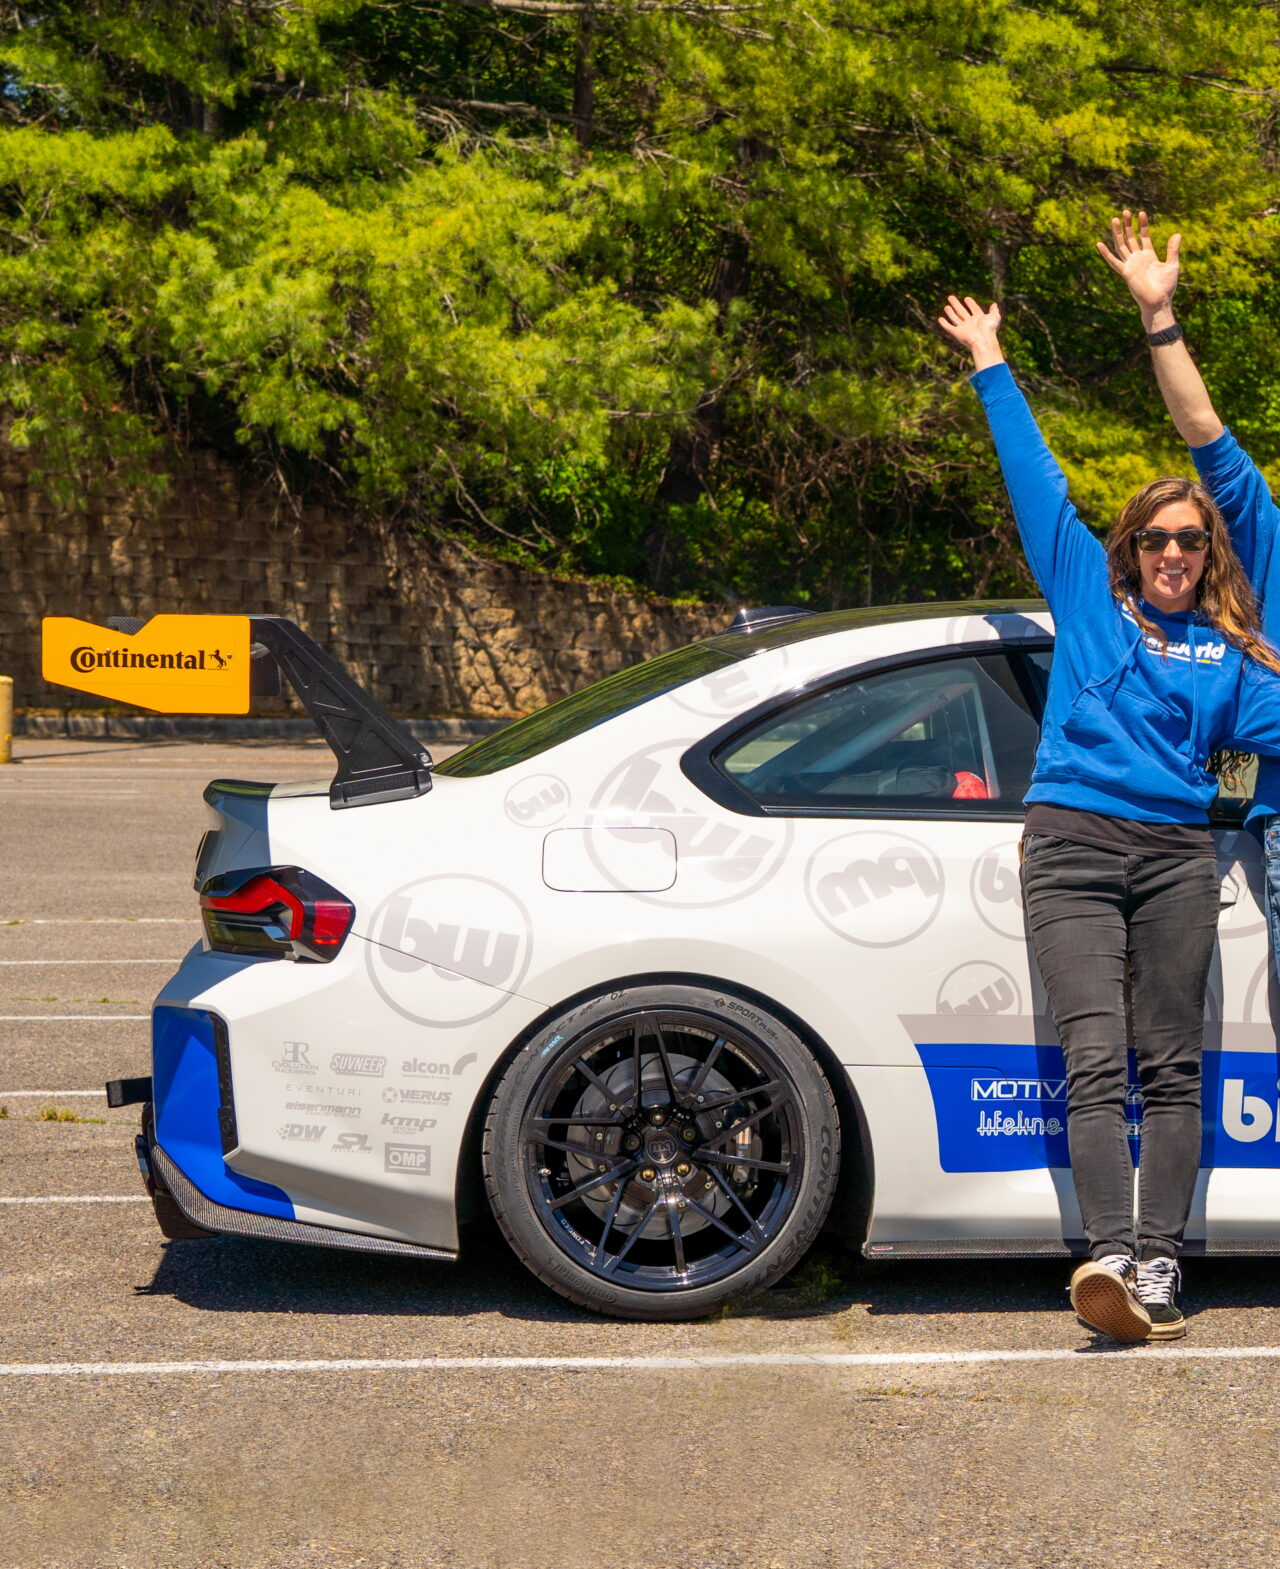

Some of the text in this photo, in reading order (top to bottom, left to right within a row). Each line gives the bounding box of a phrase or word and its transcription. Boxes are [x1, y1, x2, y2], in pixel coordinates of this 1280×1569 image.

[70, 646, 206, 673] Continental
[379, 895, 520, 987] bw
[333, 1055, 385, 1073] SUVNEER
[402, 1057, 450, 1075] alcon
[286, 1083, 361, 1096] EVENTURI
[399, 1089, 453, 1102] VERUS
[285, 1101, 362, 1115] eisenmann
[288, 1123, 327, 1139] DW
[381, 1113, 438, 1132] kmp
[977, 1110, 1063, 1136] lifeline
[389, 1151, 426, 1168] OMP
